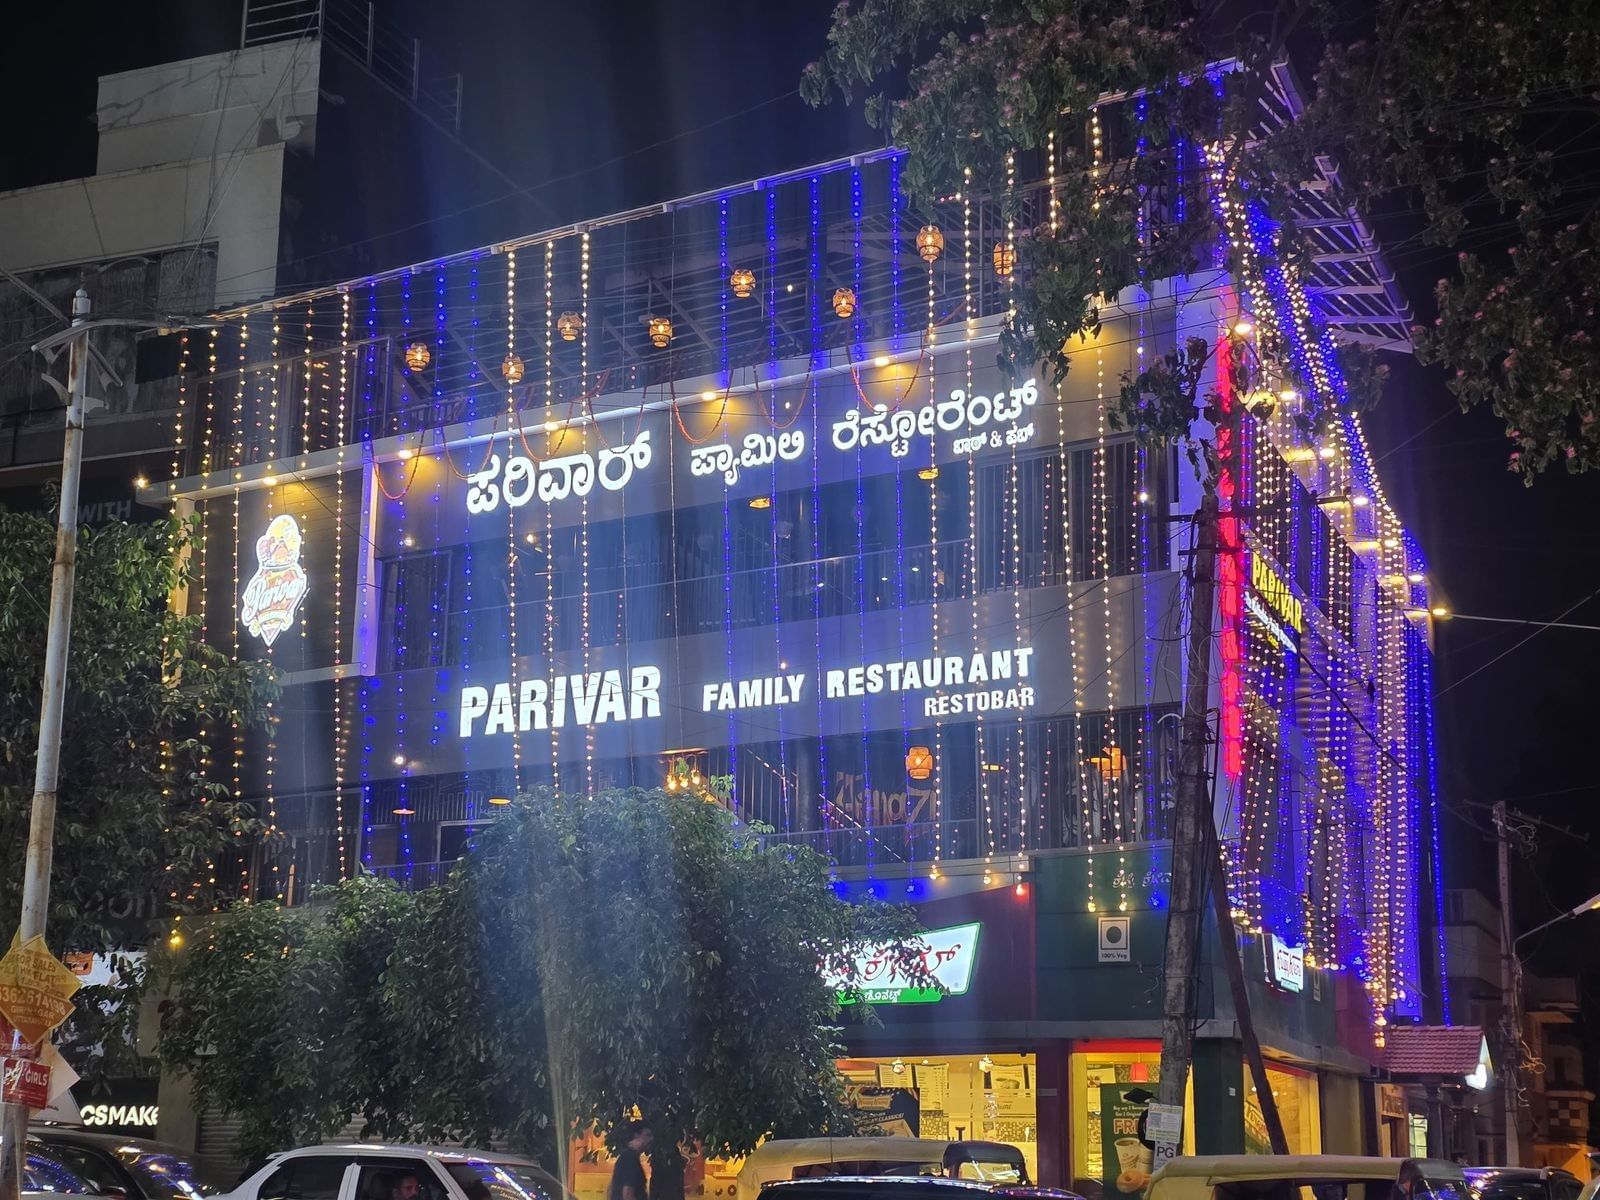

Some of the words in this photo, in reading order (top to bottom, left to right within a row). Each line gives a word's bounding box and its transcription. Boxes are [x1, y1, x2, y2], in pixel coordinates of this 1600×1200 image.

[990, 430, 1003, 448] &
[466, 430, 652, 514] ಪರಿವಾರ್
[459, 665, 661, 738] PARIVAR
[701, 673, 805, 712] FAMILY
[826, 647, 1034, 699] RESTAURANT
[924, 687, 1034, 717] RESTOBAR
[25, 1070, 48, 1087] GIRLS
[1156, 1146, 1174, 1158] PG
